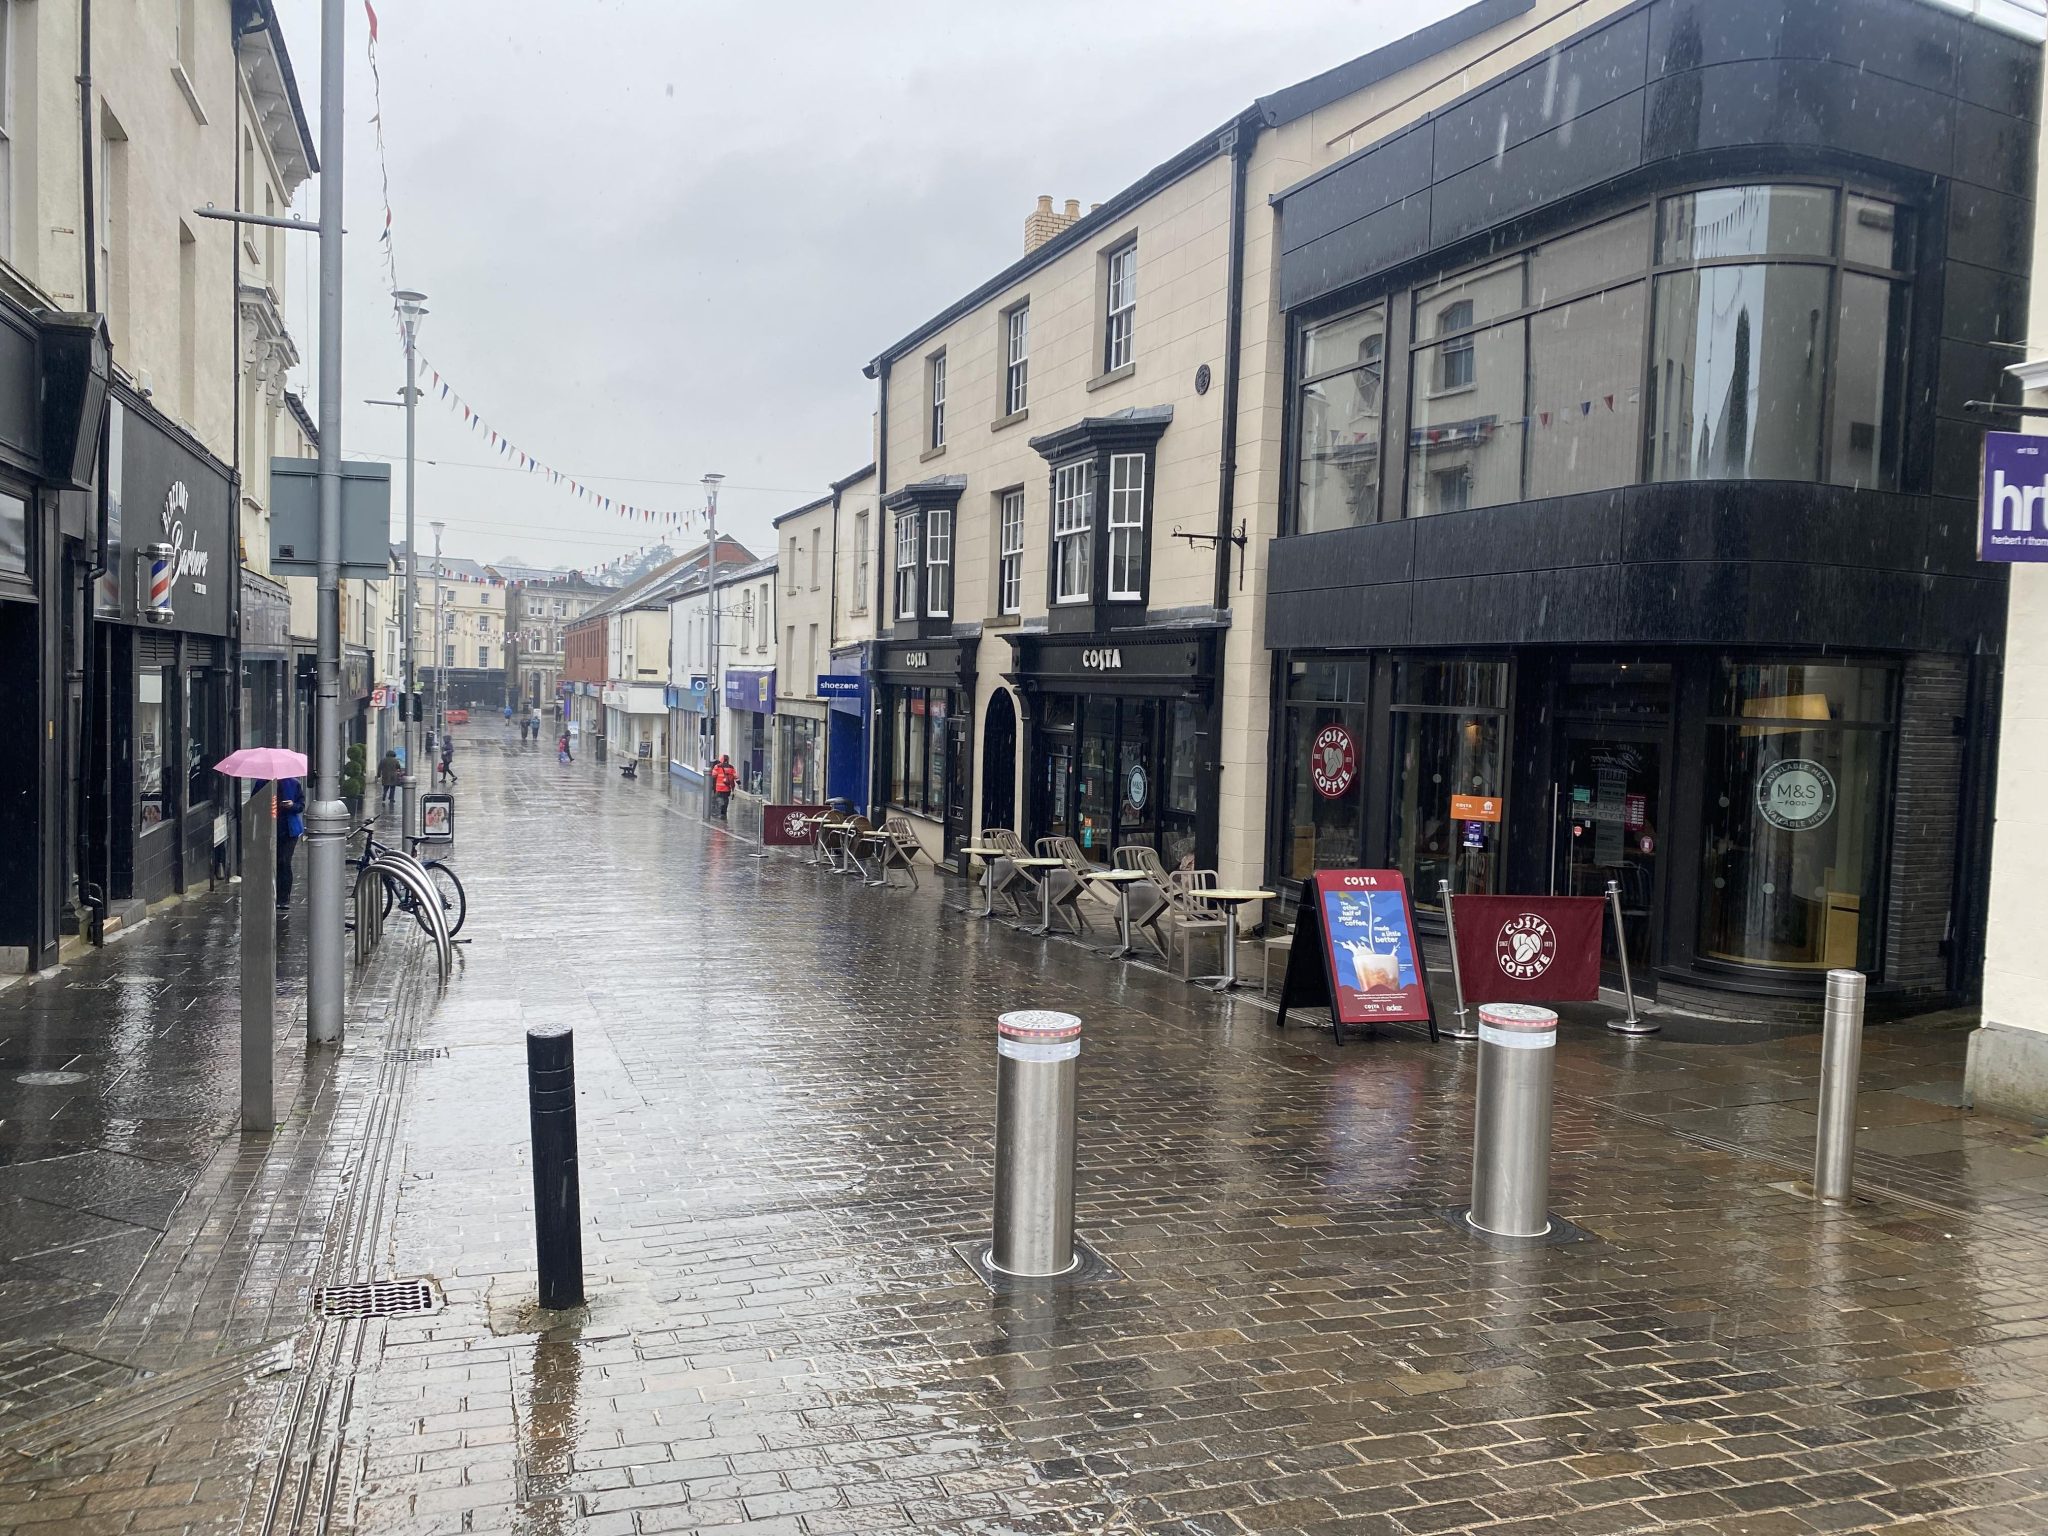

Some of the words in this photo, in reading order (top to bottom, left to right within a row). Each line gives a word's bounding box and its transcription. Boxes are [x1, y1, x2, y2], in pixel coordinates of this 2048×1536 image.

[1991, 534, 2021, 545] herbert
[171, 520, 208, 588] Barbers
[906, 652, 927, 668] COSTA
[1082, 649, 1122, 671] COSTA
[820, 681, 859, 690] shoezone
[1318, 729, 1349, 751] COSTA
[1315, 768, 1350, 793] COFFEE
[1766, 763, 1810, 784] AVAILABLE
[1811, 768, 1829, 785] HERE
[1777, 784, 1816, 799] M&S
[787, 812, 807, 821] COSTA
[1808, 807, 1826, 824] HER
[1344, 876, 1377, 886] COSTA
[1505, 916, 1547, 936] COSTA
[1374, 935, 1399, 943] better
[1500, 953, 1551, 977] COFFEE
